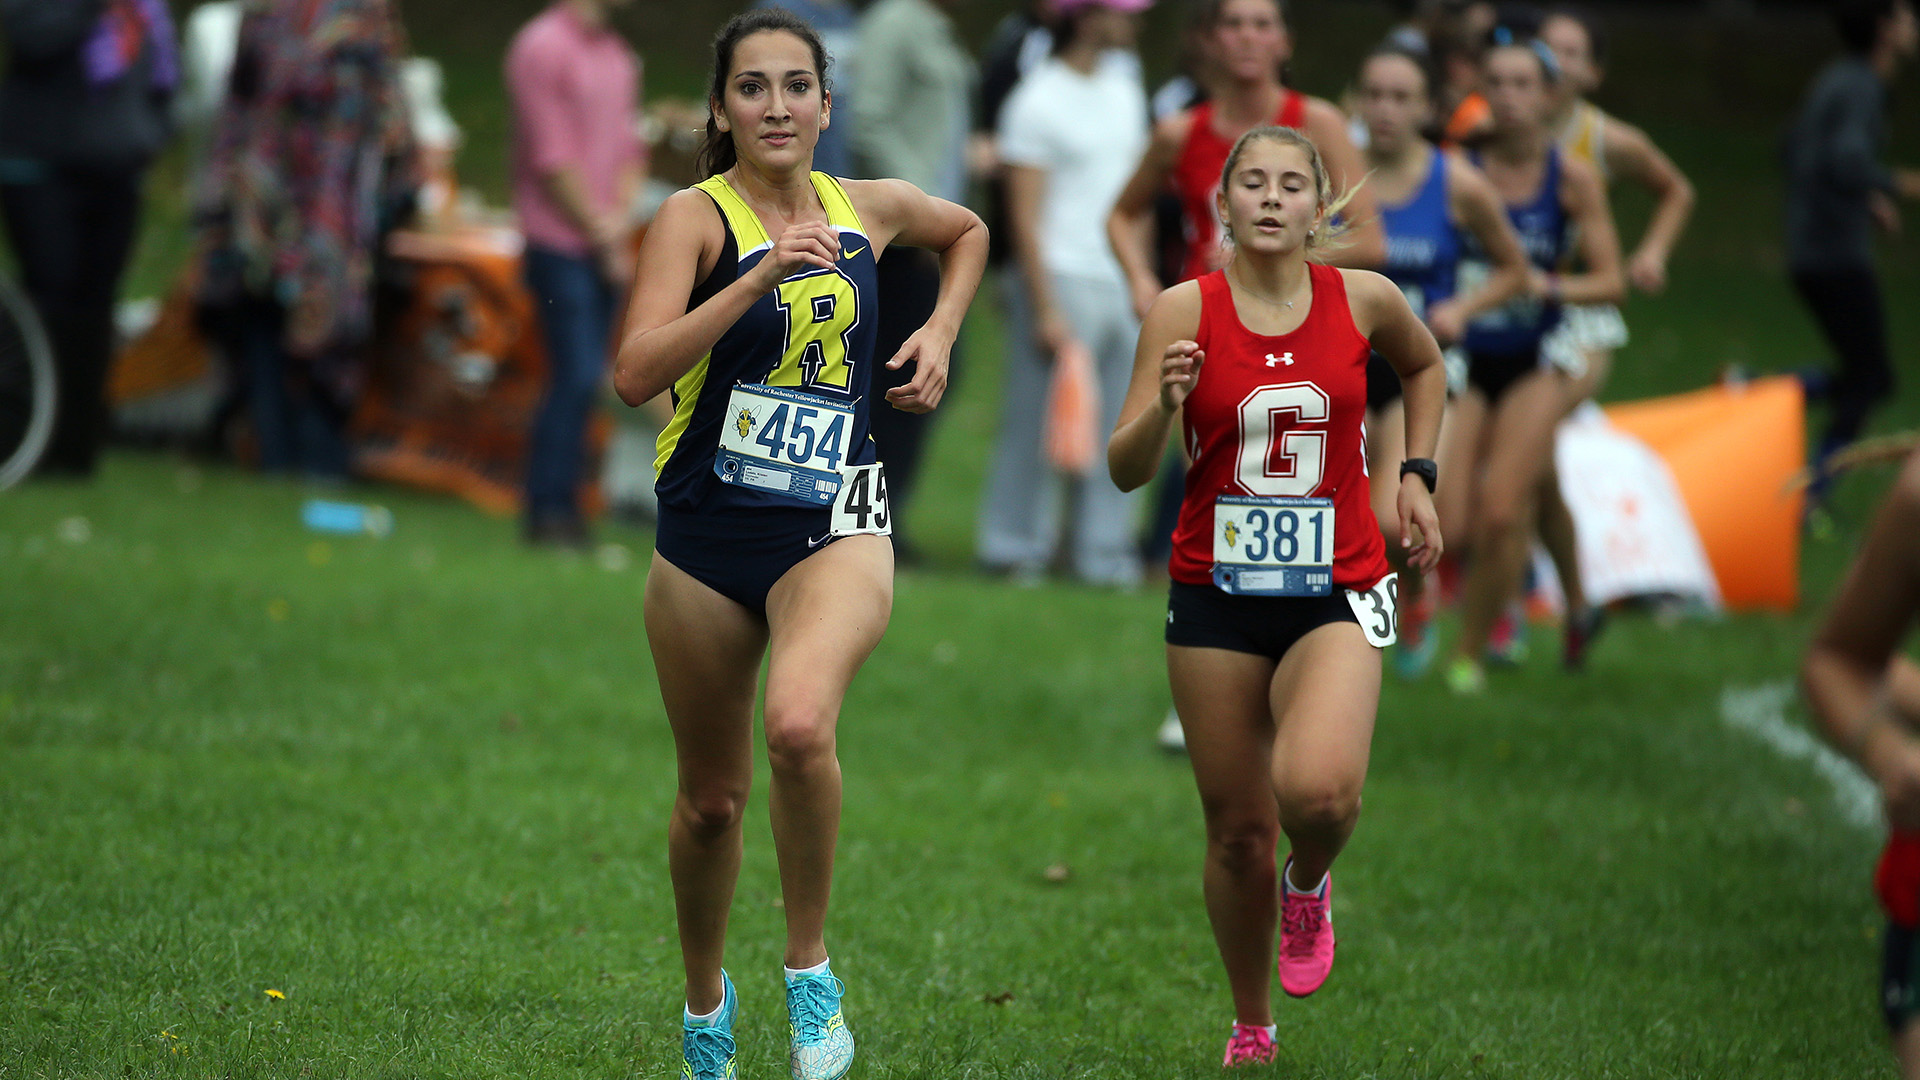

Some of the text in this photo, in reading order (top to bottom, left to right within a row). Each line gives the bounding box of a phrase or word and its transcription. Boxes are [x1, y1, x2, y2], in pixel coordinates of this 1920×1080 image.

[761, 267, 860, 394] R
[771, 388, 794, 399] Rochester
[755, 402, 845, 470] 454
[1234, 380, 1331, 497] G
[721, 473, 734, 483] 454
[1245, 509, 1323, 563] 381
